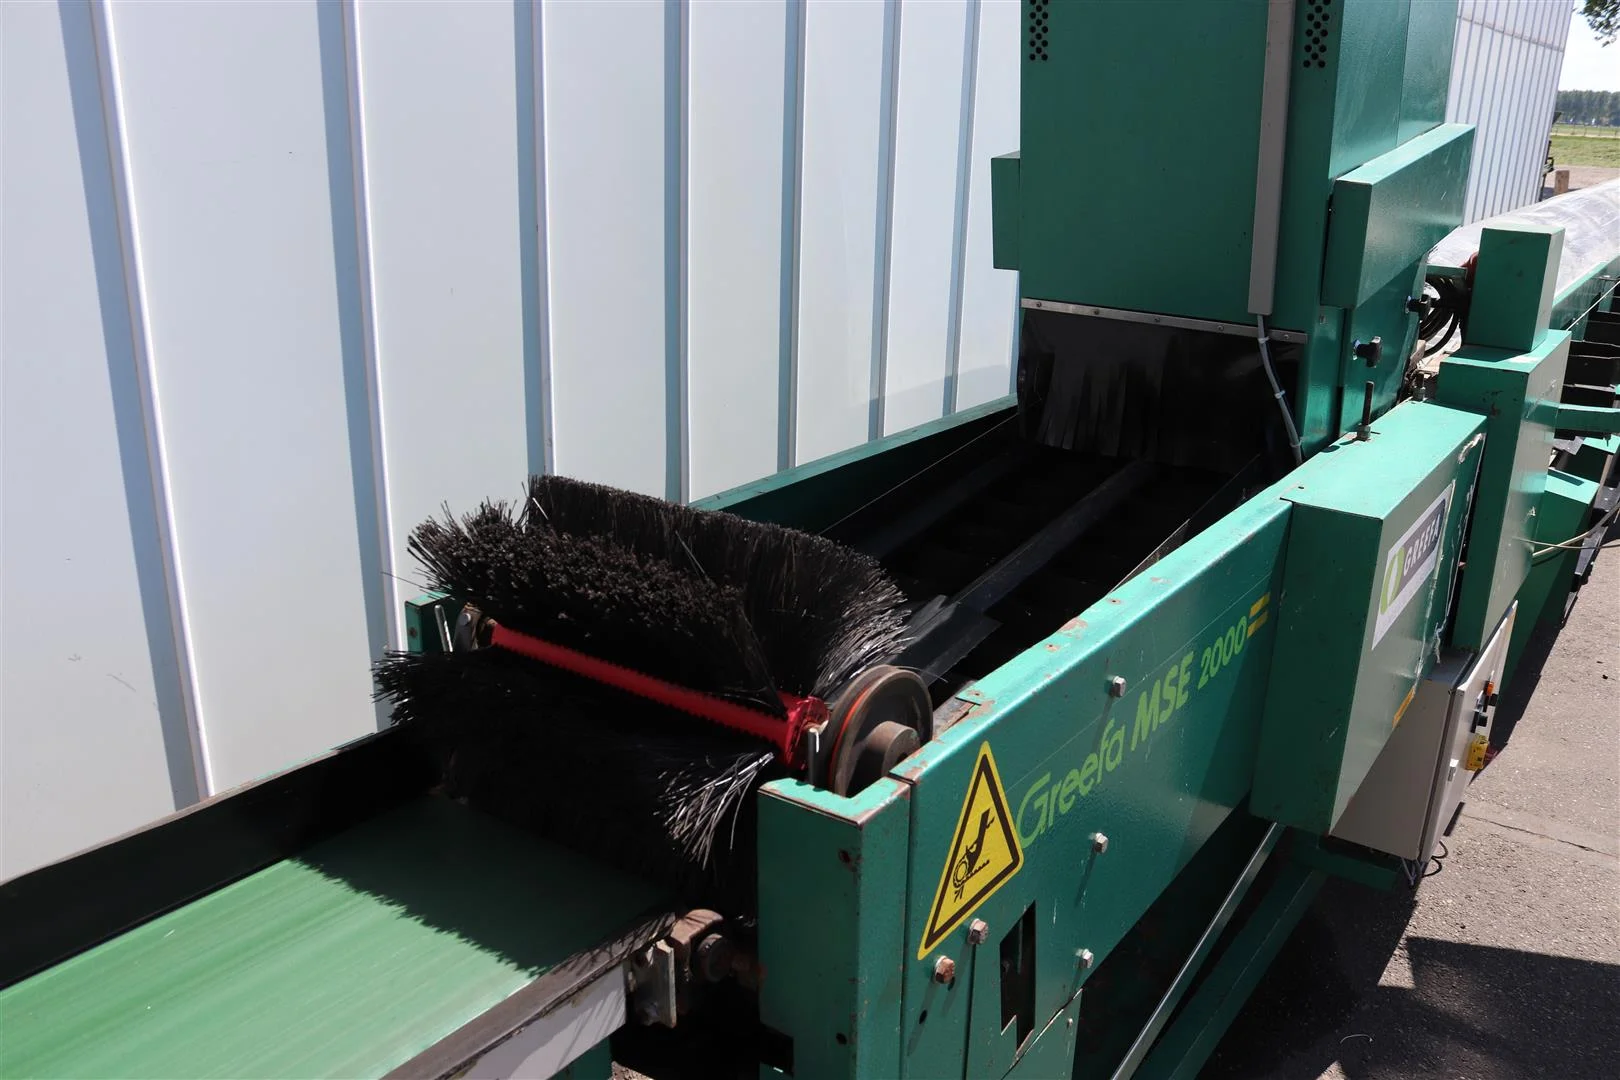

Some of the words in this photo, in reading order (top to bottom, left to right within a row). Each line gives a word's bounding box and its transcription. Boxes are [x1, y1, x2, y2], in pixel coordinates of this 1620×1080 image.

[1404, 514, 1440, 576] GREEFA
[1016, 718, 1126, 849] Greefa
[1131, 651, 1194, 751] MSE
[1198, 616, 1247, 690] 2000
